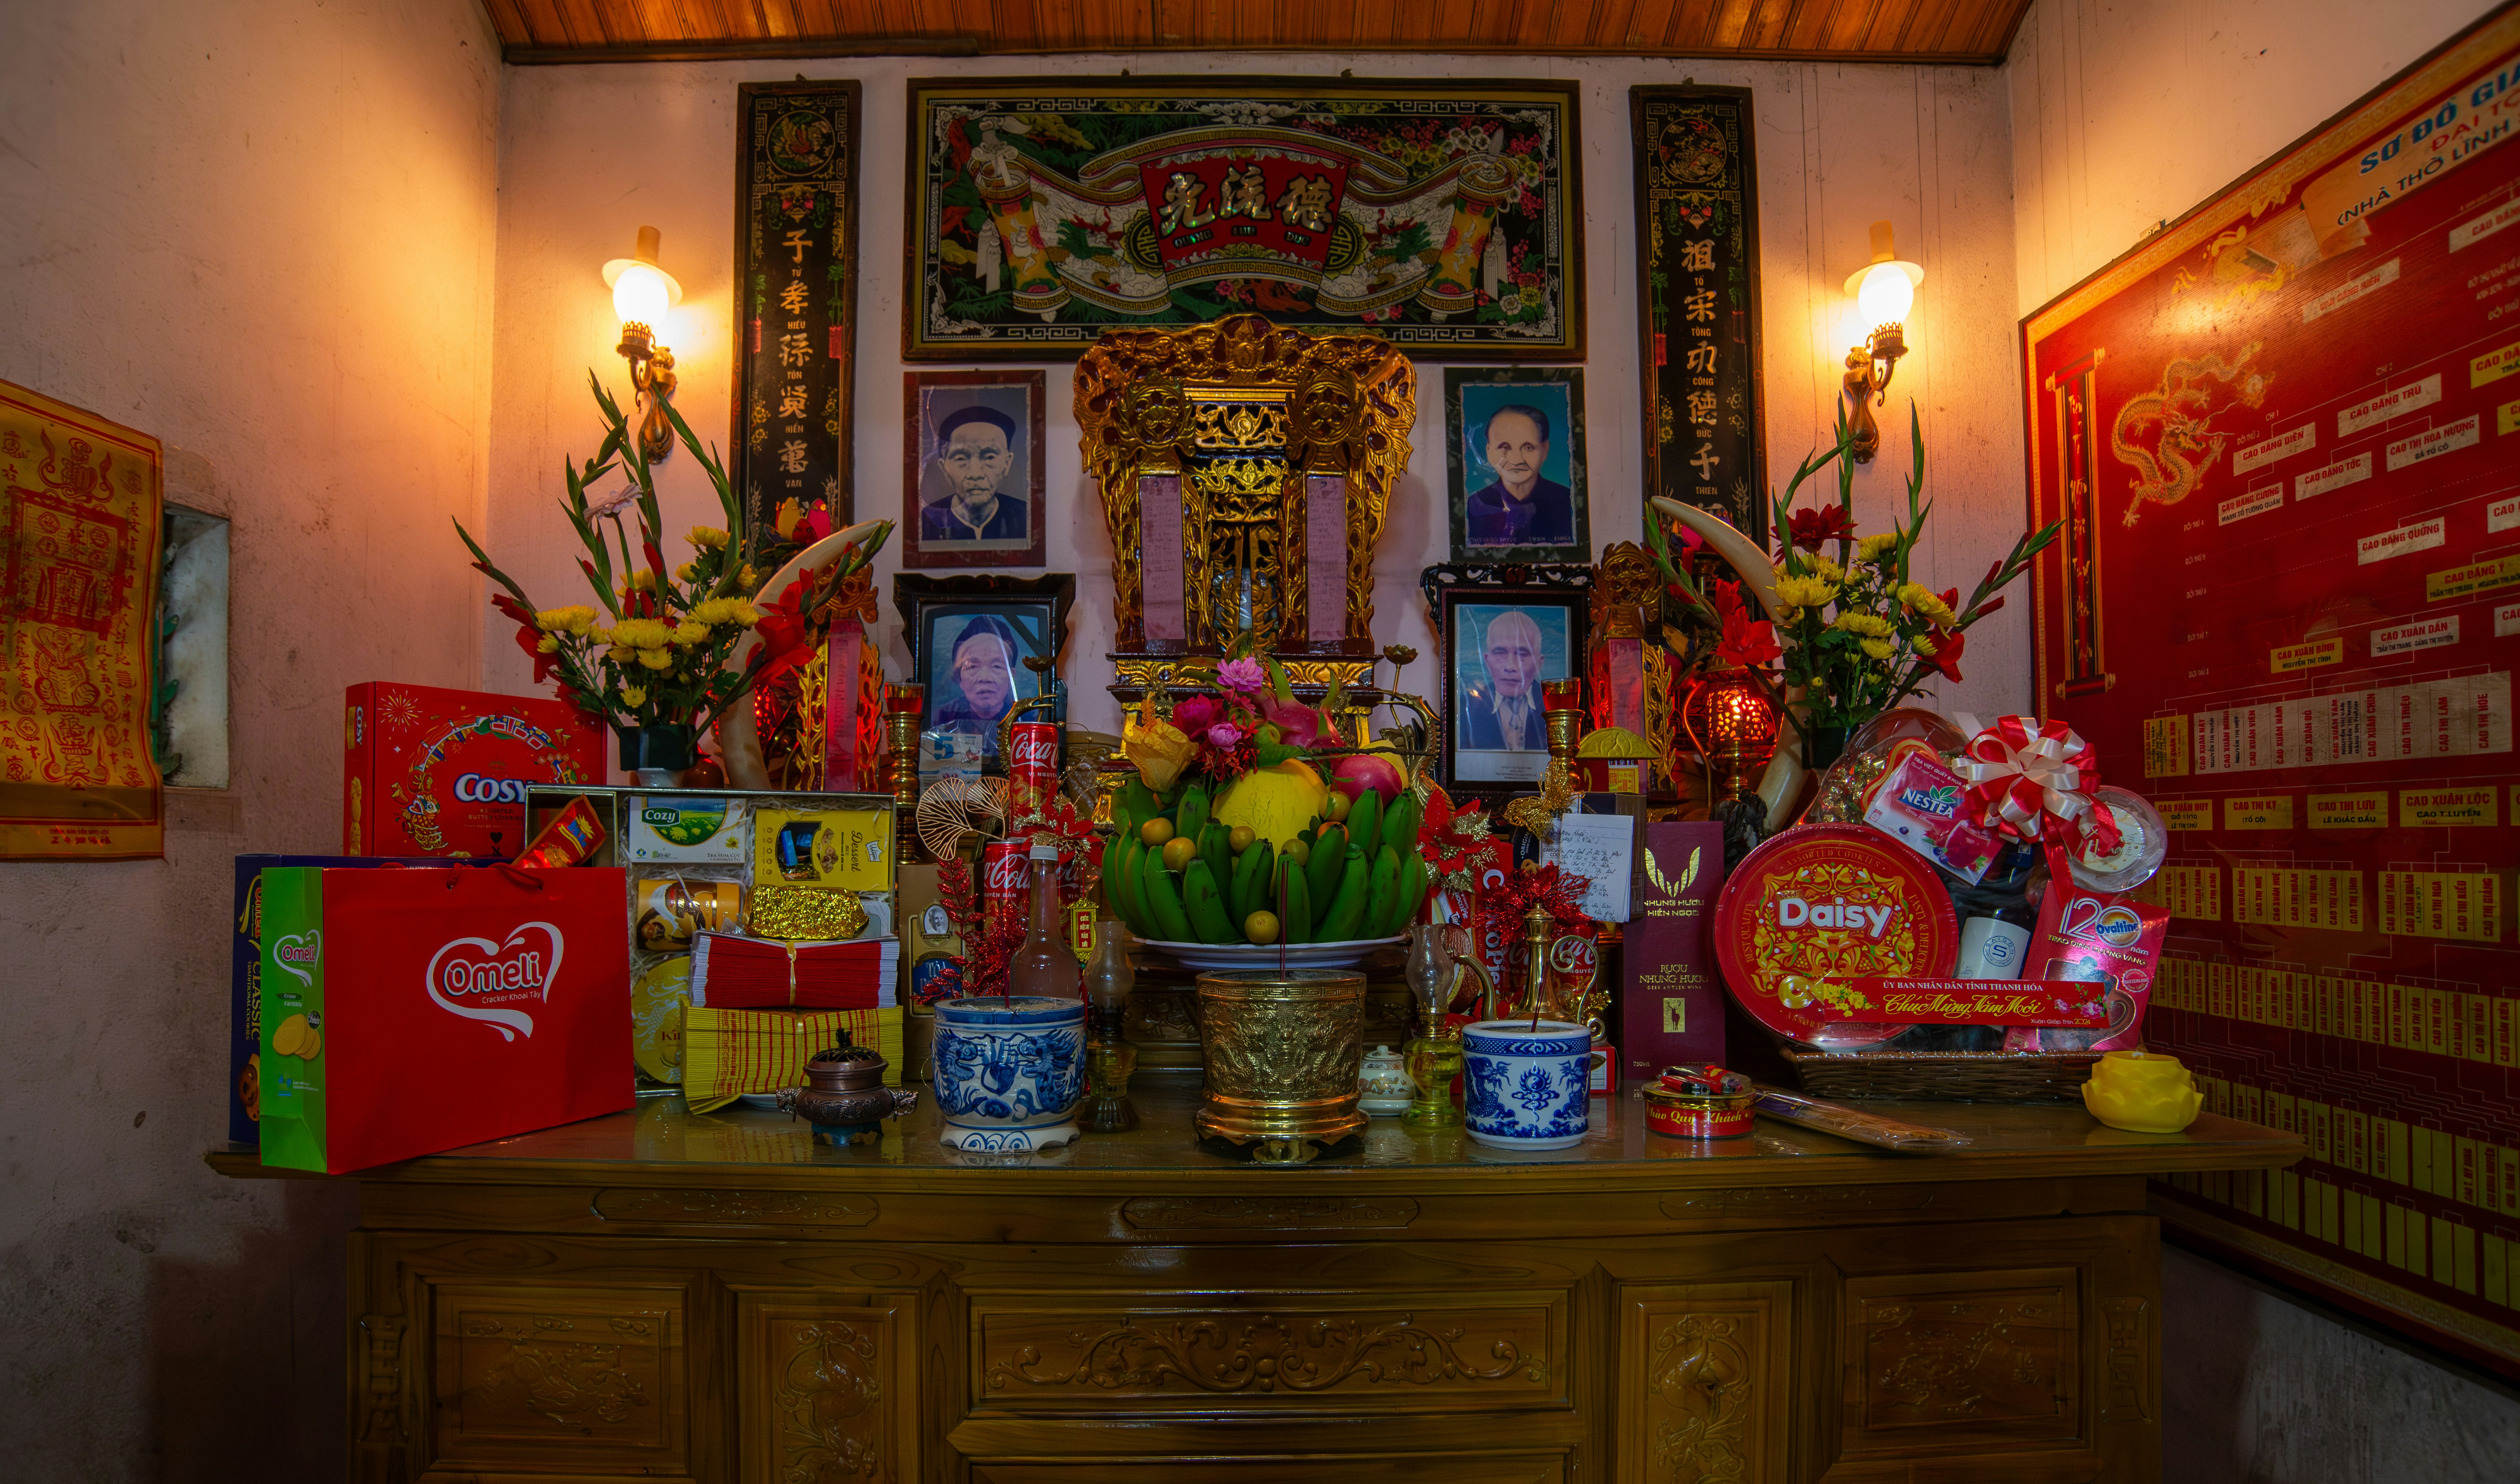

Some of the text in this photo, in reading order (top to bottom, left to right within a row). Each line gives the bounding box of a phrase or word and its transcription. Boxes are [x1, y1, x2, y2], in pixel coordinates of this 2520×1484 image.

[2360, 133, 2403, 174] SƠ
[782, 228, 813, 264] 子
[1681, 239, 1716, 272] 祖
[780, 280, 809, 314] 孝
[778, 333, 813, 367] 孫
[2390, 443, 2406, 455] CAO
[2409, 437, 2421, 450] THỊ
[2424, 432, 2441, 444] HOA
[2243, 449, 2258, 460] CAO
[2494, 504, 2514, 517] CAO
[2381, 631, 2398, 642] CAO
[2401, 626, 2425, 638] XUÂN
[2277, 646, 2314, 660] CAO XUÂN
[2365, 716, 2376, 738] XUÂN
[2439, 718, 2449, 731] THỊ
[2275, 726, 2284, 747] XUÂN
[2440, 734, 2448, 752] CAO
[2479, 731, 2489, 748] CAO
[2367, 741, 2376, 757] CAO
[454, 773, 537, 803] COSY
[1951, 778, 1962, 786] HOA
[1902, 787, 1954, 820] NESTEA
[2159, 804, 2171, 812] CAO
[2174, 801, 2193, 812] XUÂN
[2406, 791, 2491, 807] CAO XUÂN LỘC
[645, 809, 675, 823] Cozy
[851, 830, 862, 873] Dessert
[1787, 850, 1881, 867] ASSORTED COOKIES
[1779, 895, 1893, 940] Daisy
[2096, 920, 2140, 935] Ovaltine
[1986, 937, 2014, 955] SAIGON
[2047, 933, 2069, 946] TRAO
[281, 944, 316, 963] Omeli
[1741, 942, 1755, 963] BEST
[2130, 946, 2149, 956] năm
[443, 950, 543, 997] Omeli
[1639, 975, 1677, 983] NHUNG
[1883, 980, 1896, 989] ỦY
[1917, 980, 1944, 990] NHÂN
[1944, 980, 1963, 990] DÂN
[1964, 981, 1987, 990] TỈNH
[2023, 982, 2044, 992] HÓA
[283, 1000, 302, 1008] Fantasy
[481, 990, 542, 1004] Cracker Khoai Tây
[1883, 993, 2045, 1019] Chúc Mừng Năm Mới
[1670, 1110, 1696, 1125] Quý
[1700, 1110, 1742, 1124] Khách
